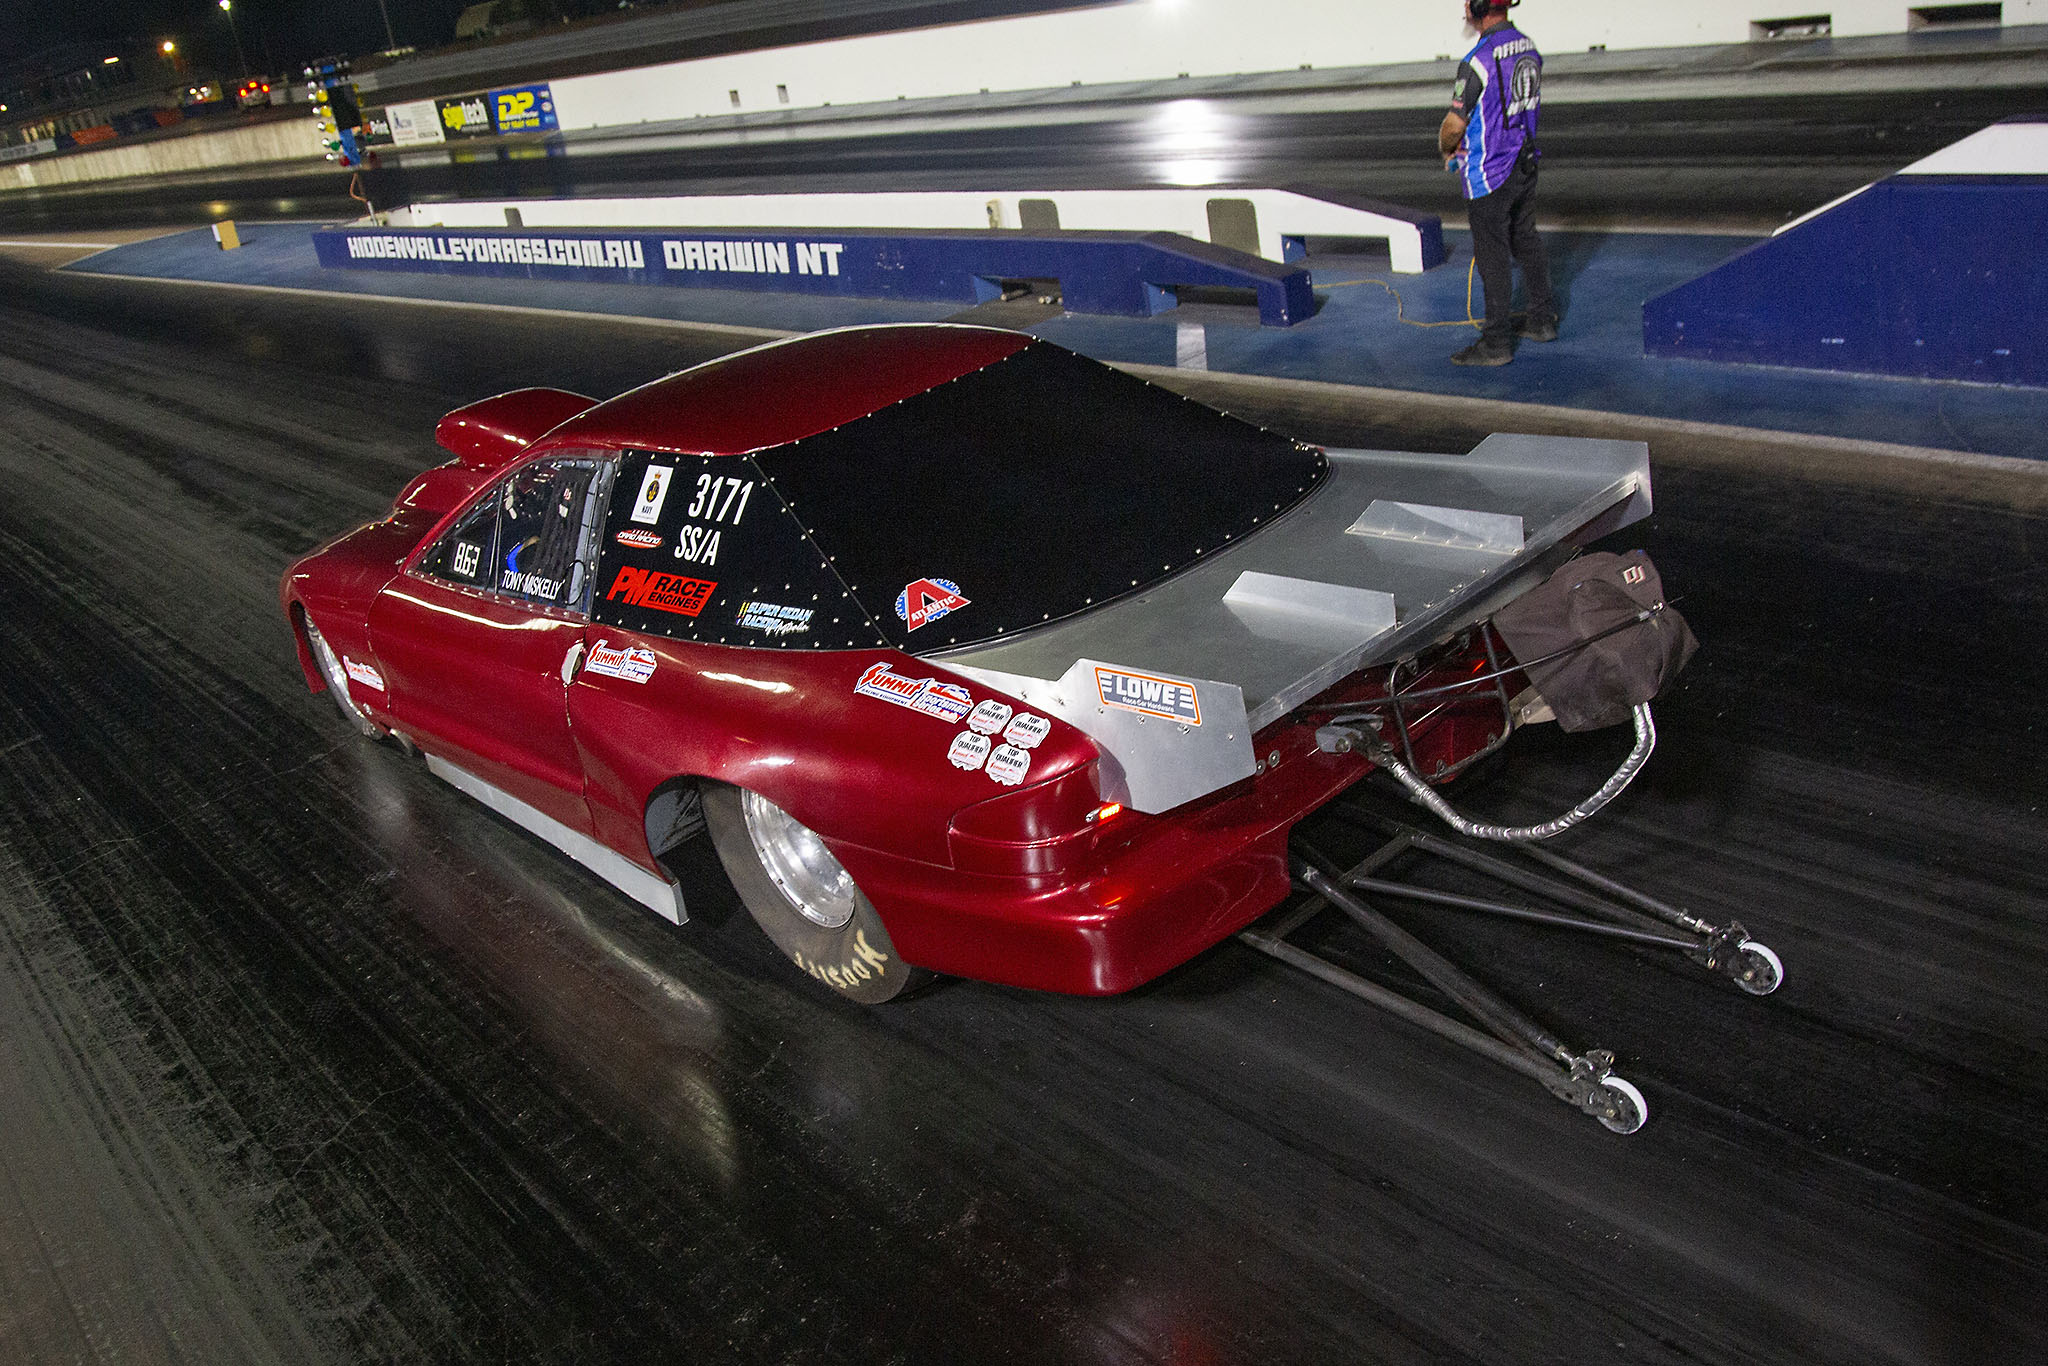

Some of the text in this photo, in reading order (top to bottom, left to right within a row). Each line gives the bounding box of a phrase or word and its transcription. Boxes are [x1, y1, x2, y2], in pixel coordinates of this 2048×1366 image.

[1493, 37, 1537, 60] OFFICIA
[347, 236, 843, 276] HIDDENVALLEYDRAGS.COM.AU DARWIN NT
[688, 473, 754, 526] 3171
[674, 524, 721, 567] SS/A
[502, 569, 526, 592] TONY
[606, 565, 654, 607] PM
[654, 577, 711, 599] RACE
[648, 592, 701, 610] ENGINES
[911, 595, 957, 622] ATLANTIC
[1116, 676, 1176, 706] LOWE
